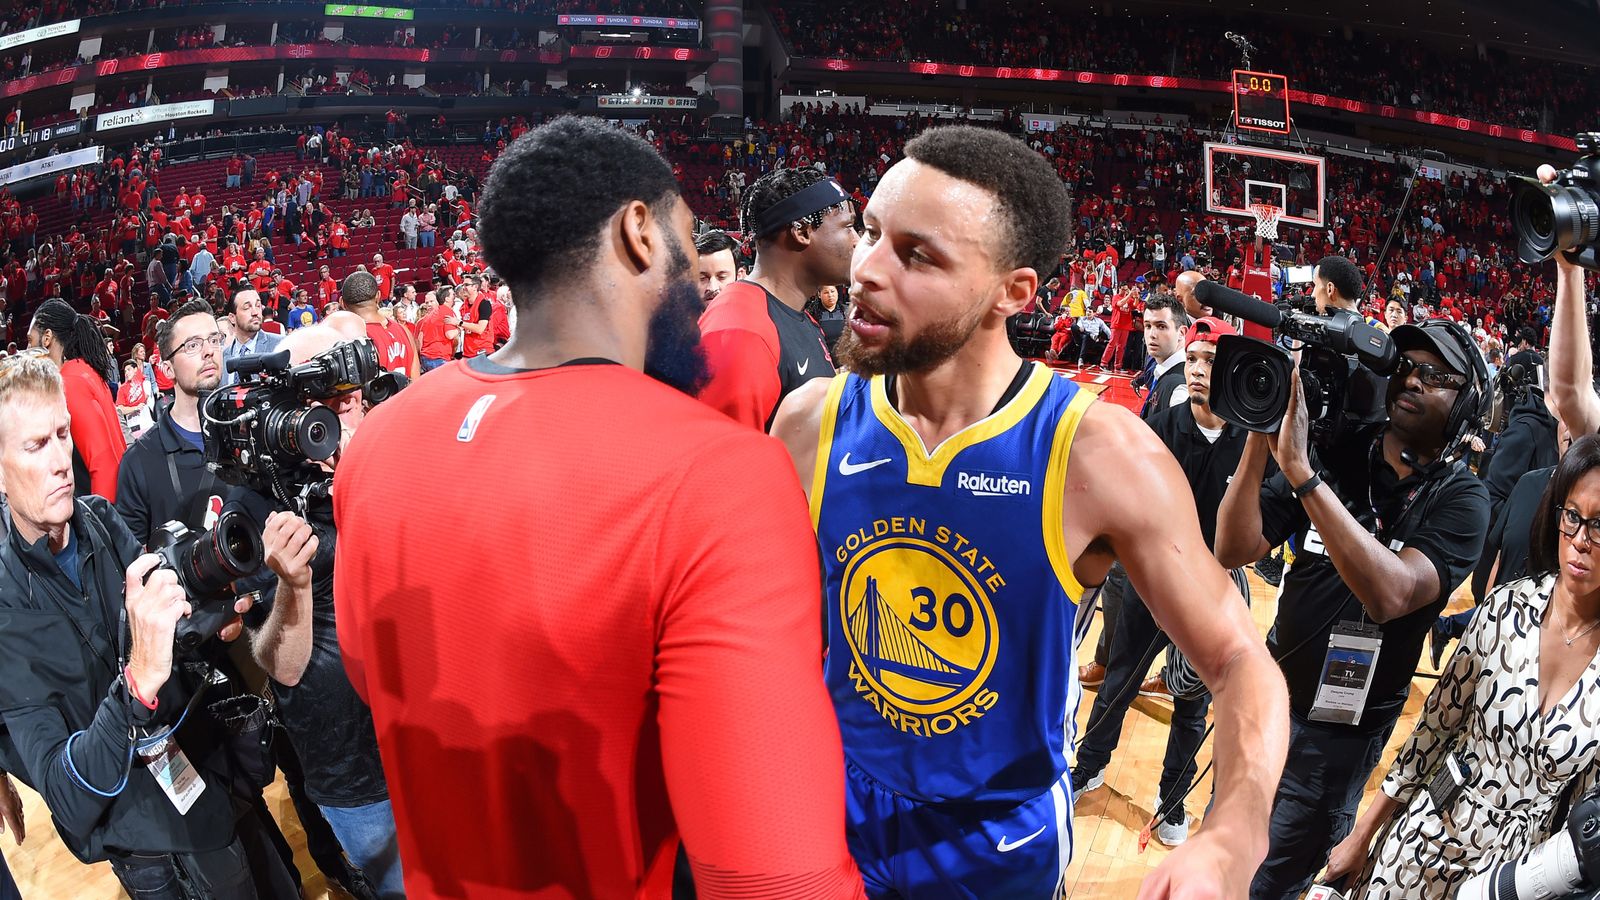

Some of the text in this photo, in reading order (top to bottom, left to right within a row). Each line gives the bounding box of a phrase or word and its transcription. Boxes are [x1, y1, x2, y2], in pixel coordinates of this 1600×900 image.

[1250, 77, 1271, 92] 0.0
[102, 113, 135, 128] reliant
[1252, 118, 1286, 129] TISSOT
[41, 161, 55, 170] AT&T
[957, 471, 1031, 496] Rakuten
[836, 517, 1007, 593] GOLDEN STATE
[908, 586, 974, 638] 30
[848, 659, 999, 738] WARRIORS
